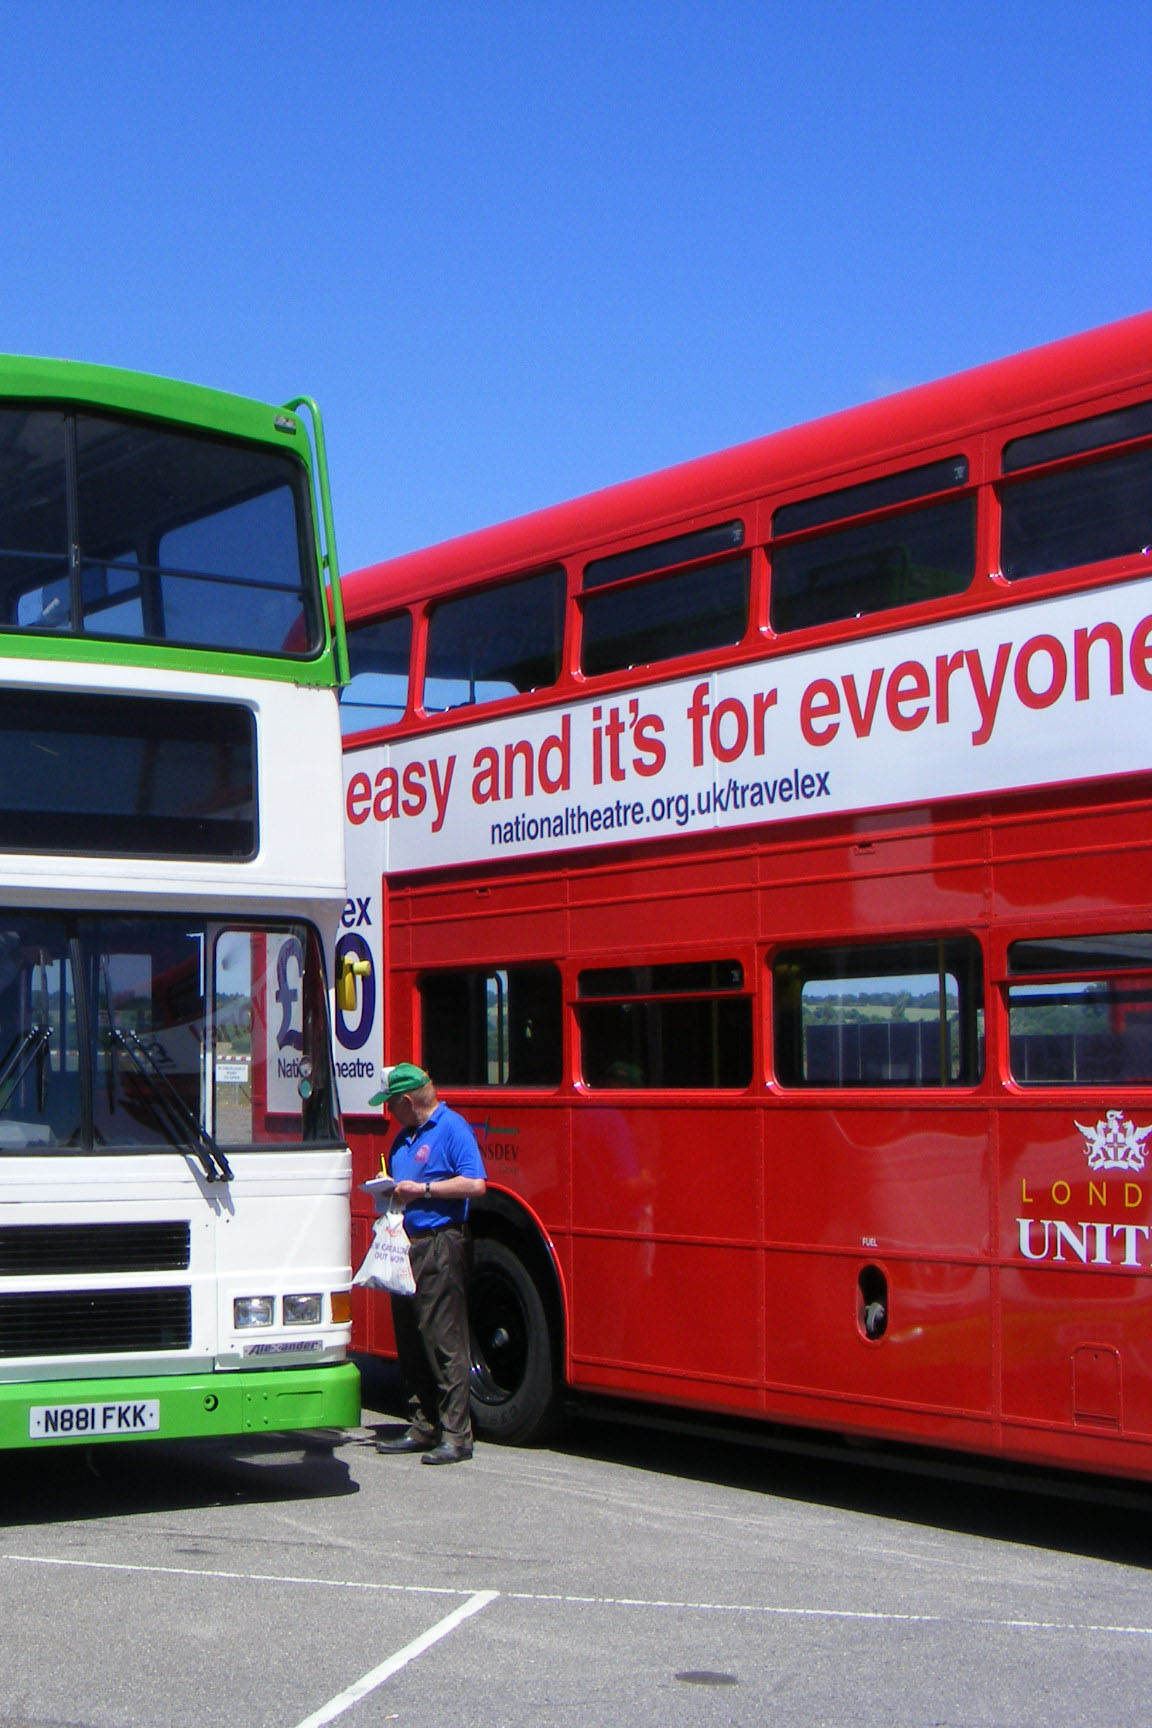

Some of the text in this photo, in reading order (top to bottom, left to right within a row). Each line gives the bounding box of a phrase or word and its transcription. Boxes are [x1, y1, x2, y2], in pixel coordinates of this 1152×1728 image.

[346, 754, 456, 834] easy
[471, 713, 571, 805] and
[592, 698, 667, 786] it's
[687, 682, 778, 768] for
[491, 769, 831, 845] nationaltheatre.org.uk/travelex
[338, 896, 372, 928] ex
[479, 1143, 519, 1161] NSDEV
[862, 1237, 878, 1247] FUEL
[1015, 1217, 1152, 1267] UNIT
[248, 1341, 318, 1356] Alexander
[44, 1404, 146, 1433] N881 FKK
